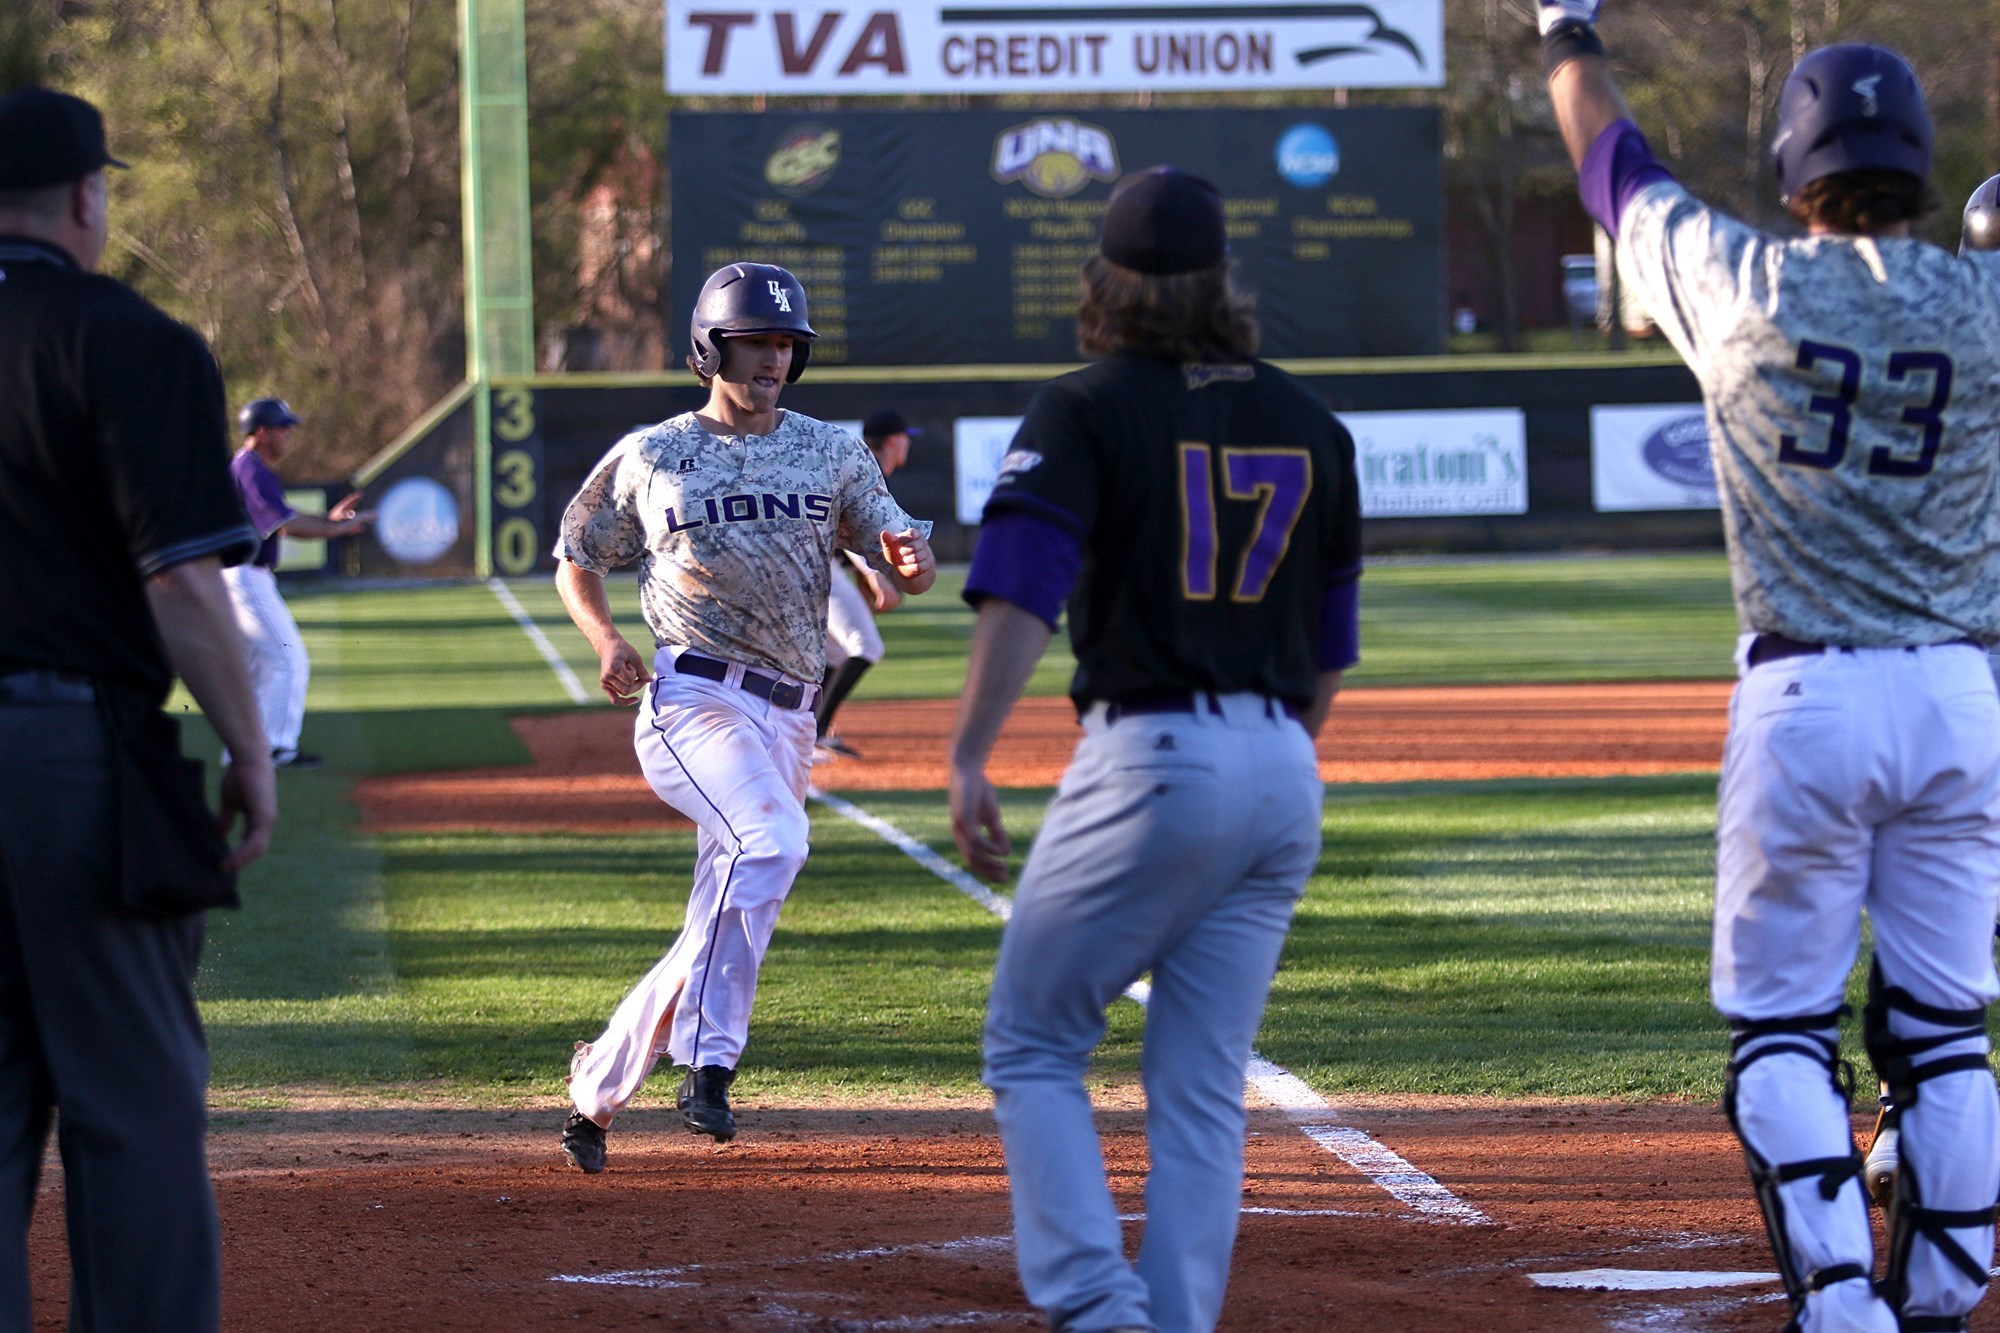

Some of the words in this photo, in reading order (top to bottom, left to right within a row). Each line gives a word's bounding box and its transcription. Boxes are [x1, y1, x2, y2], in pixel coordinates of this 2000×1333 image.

[688, 11, 907, 76] TVA
[942, 34, 1108, 77] CREDIT
[1134, 33, 1274, 76] UNION
[995, 119, 1116, 177] UNA
[767, 280, 792, 312] UNA
[1779, 339, 1954, 477] 33
[1361, 432, 1518, 484] icatoni's
[664, 493, 833, 534] LIONS
[1178, 441, 1312, 602] 17
